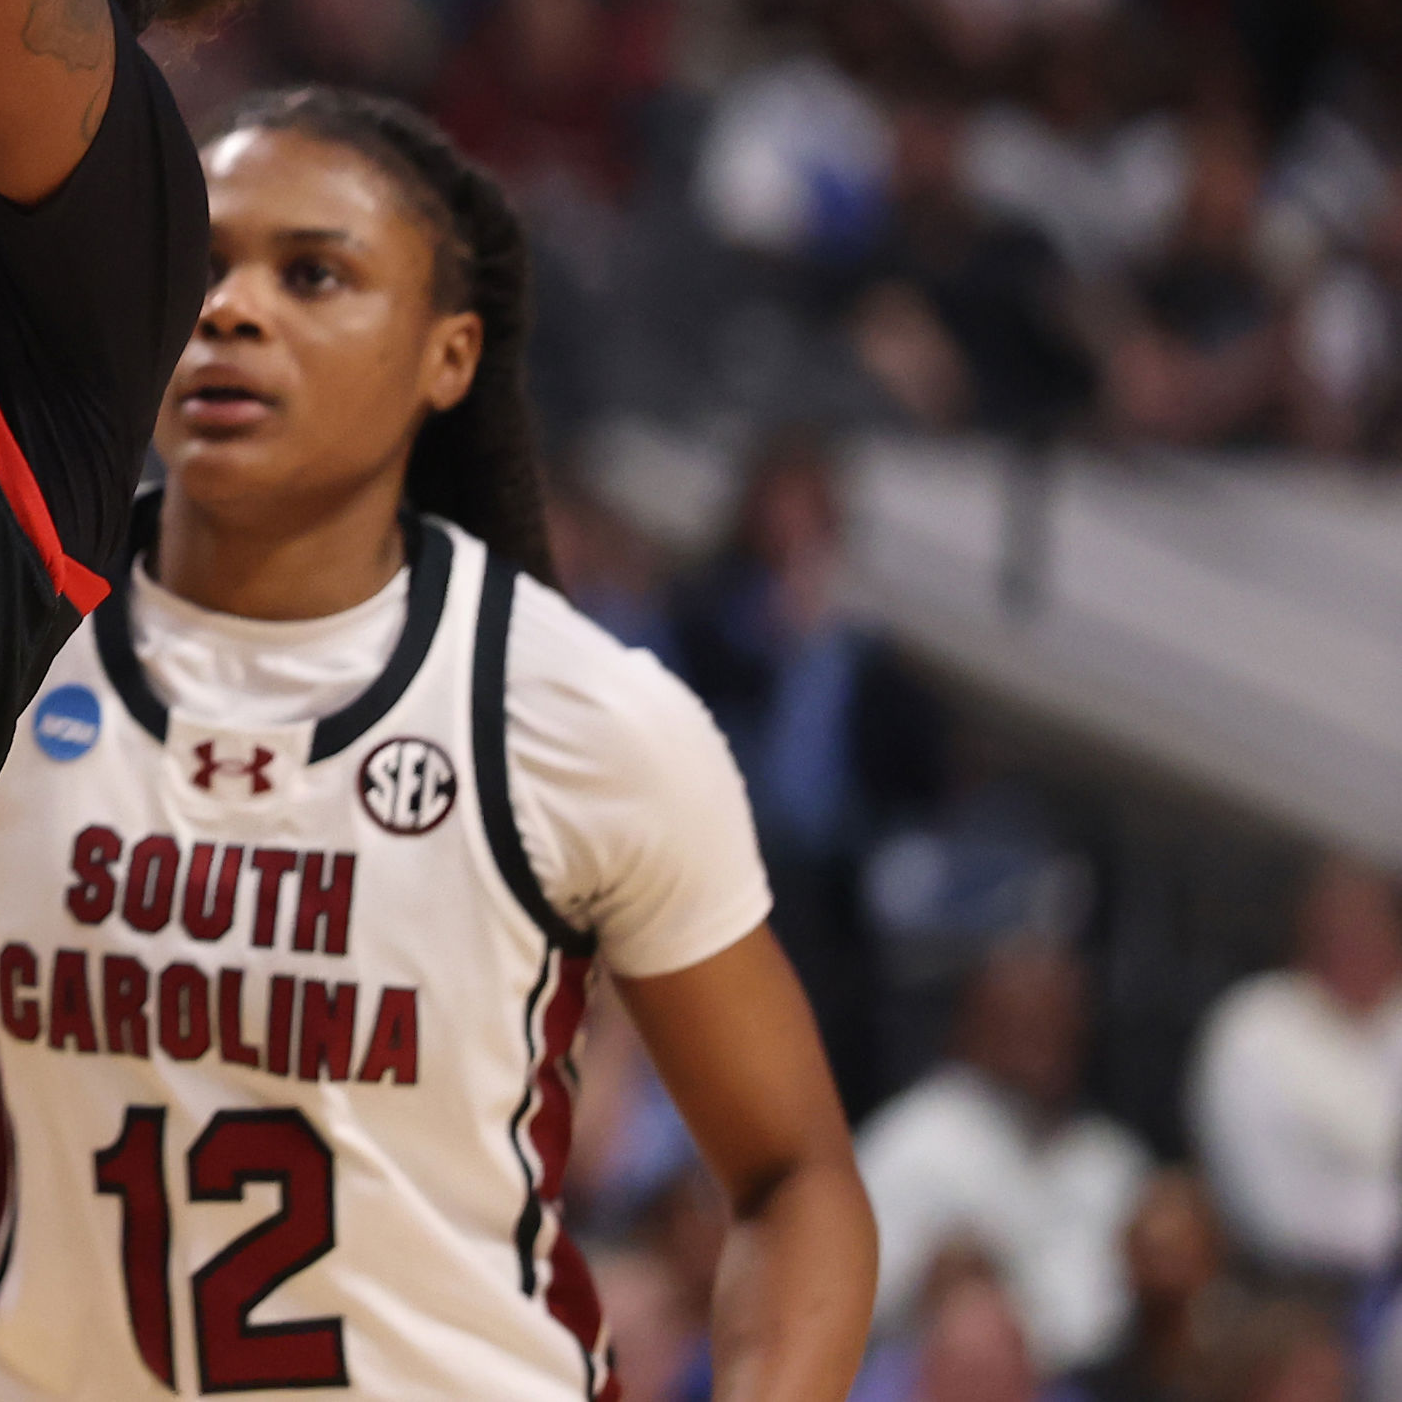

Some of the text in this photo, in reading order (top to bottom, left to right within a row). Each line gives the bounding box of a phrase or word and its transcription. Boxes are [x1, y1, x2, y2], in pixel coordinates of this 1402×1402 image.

[361, 740, 455, 831] SEC
[64, 825, 356, 956] SOUTH
[95, 1105, 351, 1396] 12
